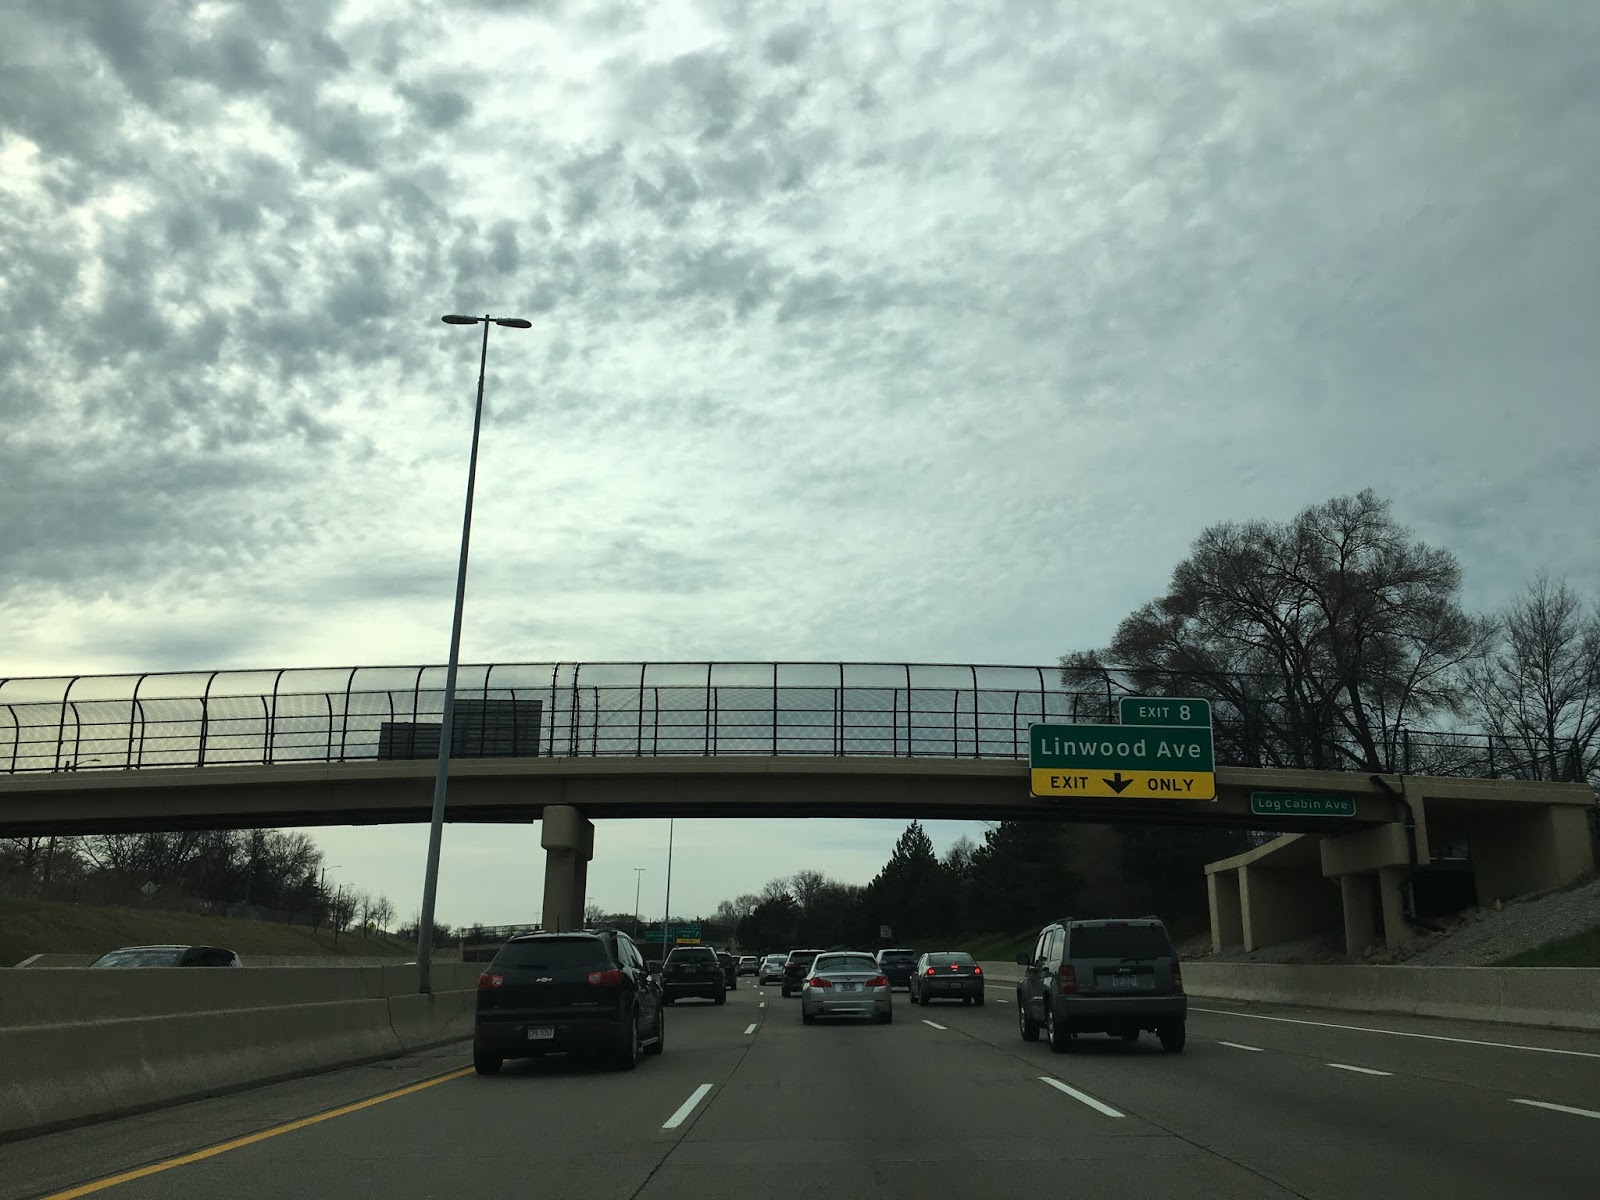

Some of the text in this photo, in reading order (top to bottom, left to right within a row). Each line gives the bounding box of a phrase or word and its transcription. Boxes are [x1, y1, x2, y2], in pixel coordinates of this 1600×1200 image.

[1139, 705, 1191, 721] EXIT 8
[1041, 737, 1201, 758] Linwood Ave
[1050, 776, 1194, 791] EXIT ONLY
[1258, 799, 1348, 811] Log Cabin Ave
